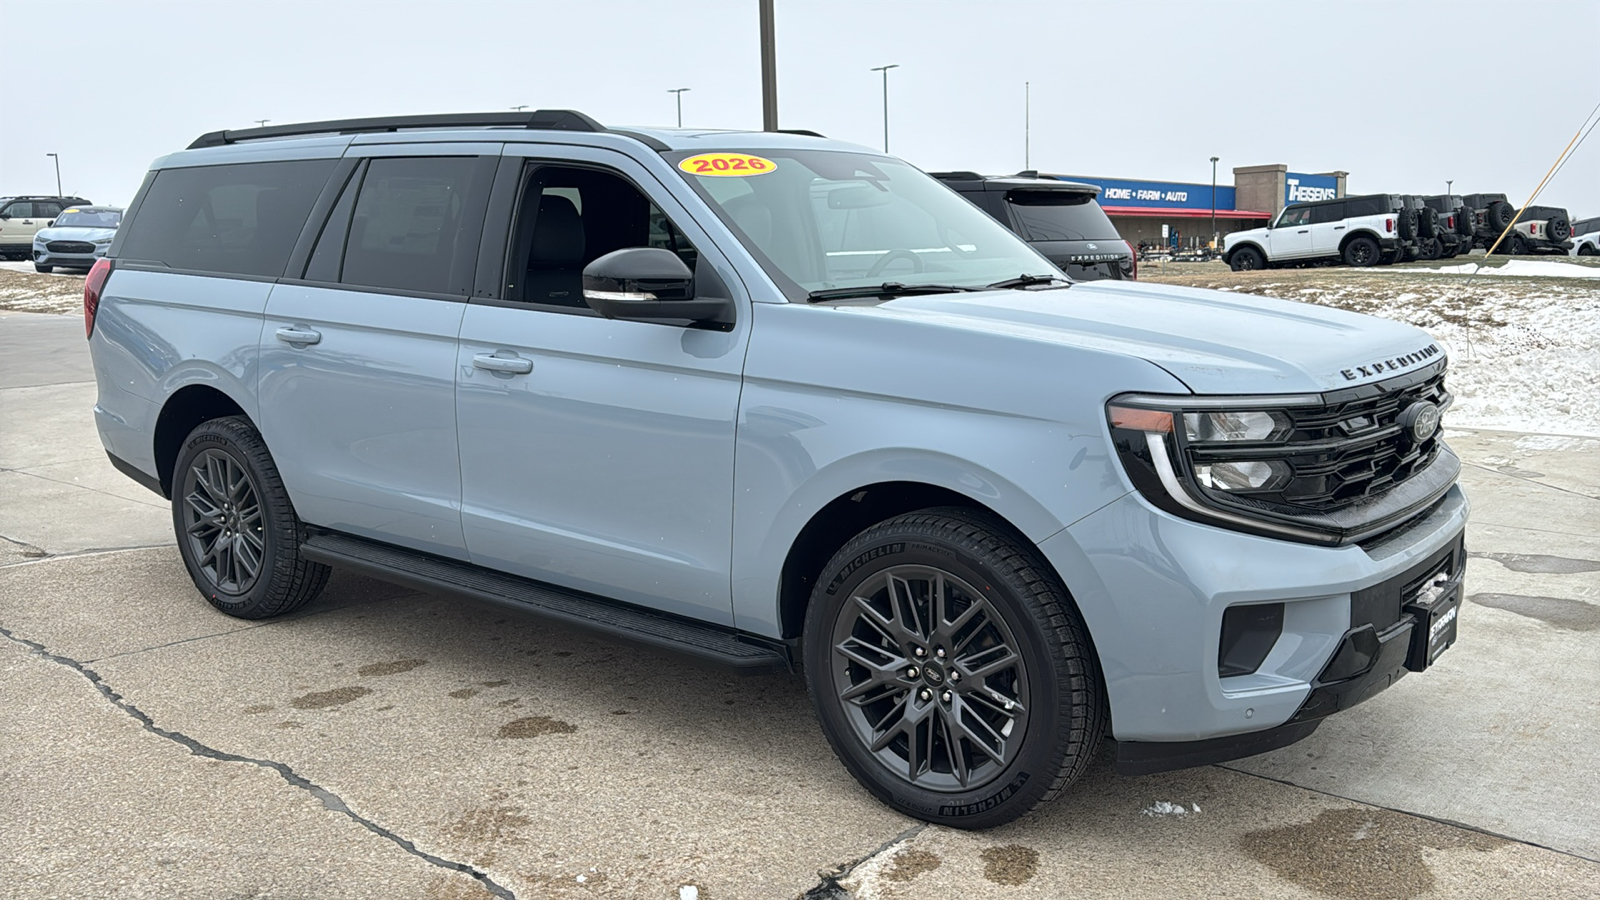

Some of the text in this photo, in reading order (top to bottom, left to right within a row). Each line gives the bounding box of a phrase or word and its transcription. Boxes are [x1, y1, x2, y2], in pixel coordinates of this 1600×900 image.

[693, 158, 766, 172] 2026
[1105, 188, 1187, 202] HOME FARM AUTO
[1287, 178, 1335, 202] THEISEN'S
[1340, 343, 1439, 380] EXPEDITION
[841, 543, 902, 580] MICHELIN
[911, 543, 941, 553] PRIMACY
[943, 787, 1012, 816] MICHELIN
